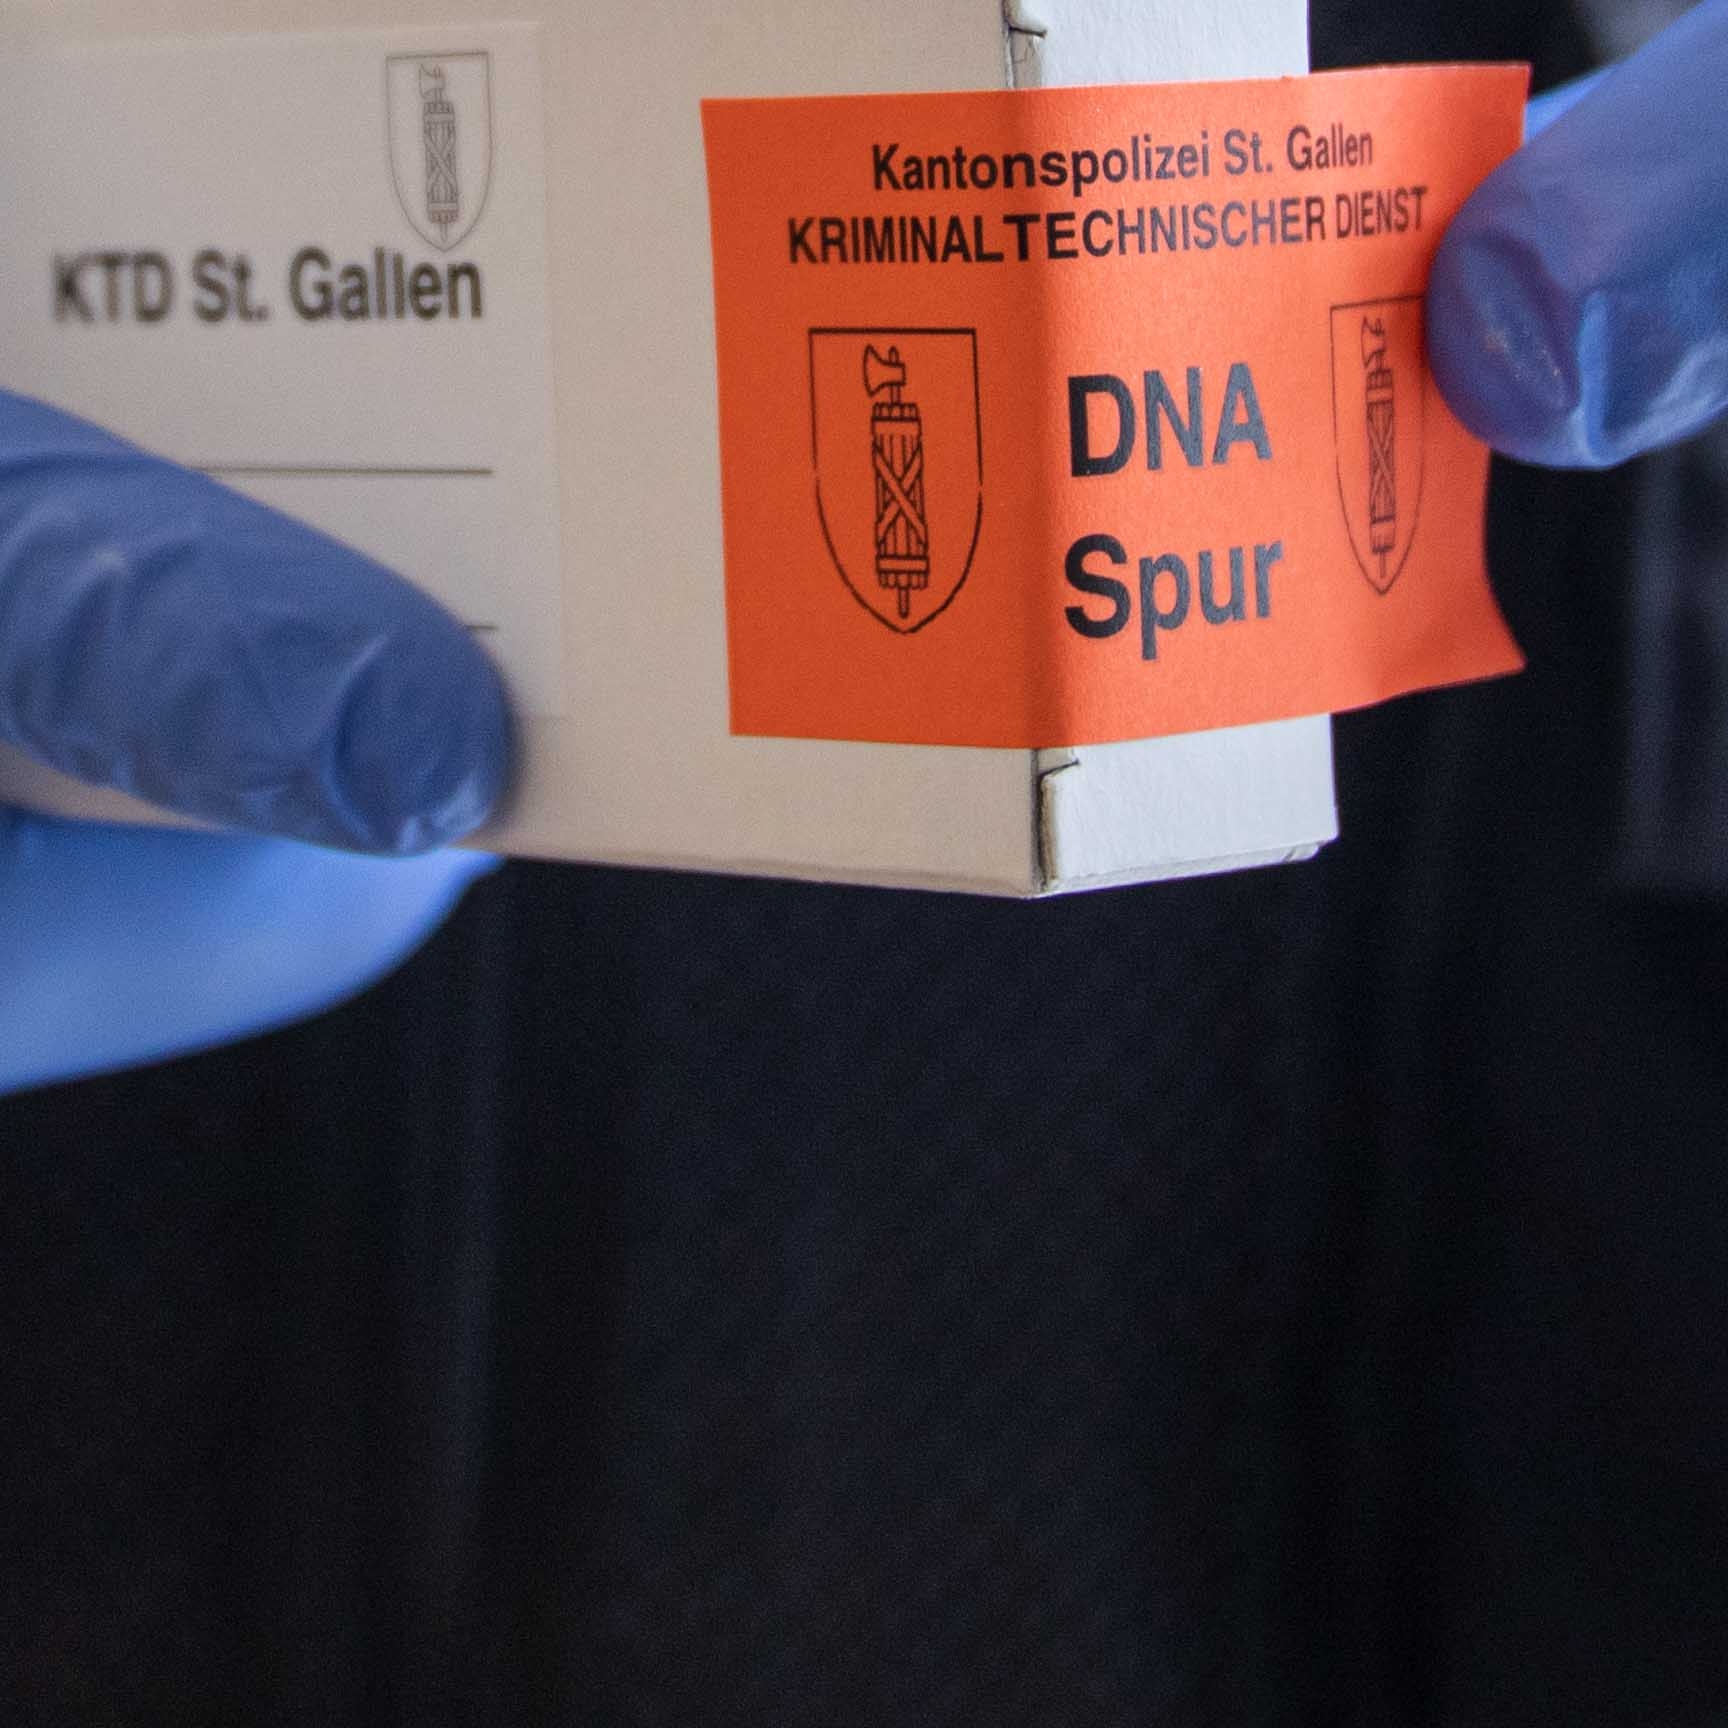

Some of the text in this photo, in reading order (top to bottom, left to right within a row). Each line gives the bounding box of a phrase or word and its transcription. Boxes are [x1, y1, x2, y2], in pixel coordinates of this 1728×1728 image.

[873, 125, 1374, 196] Kantonspolizei St. Gallen
[788, 186, 1428, 264] KRIMINALTECHNISCHER DIENST
[52, 246, 484, 325] KTD St. Gallen
[1069, 363, 1272, 478] DNA
[1064, 534, 1282, 659] Spur
